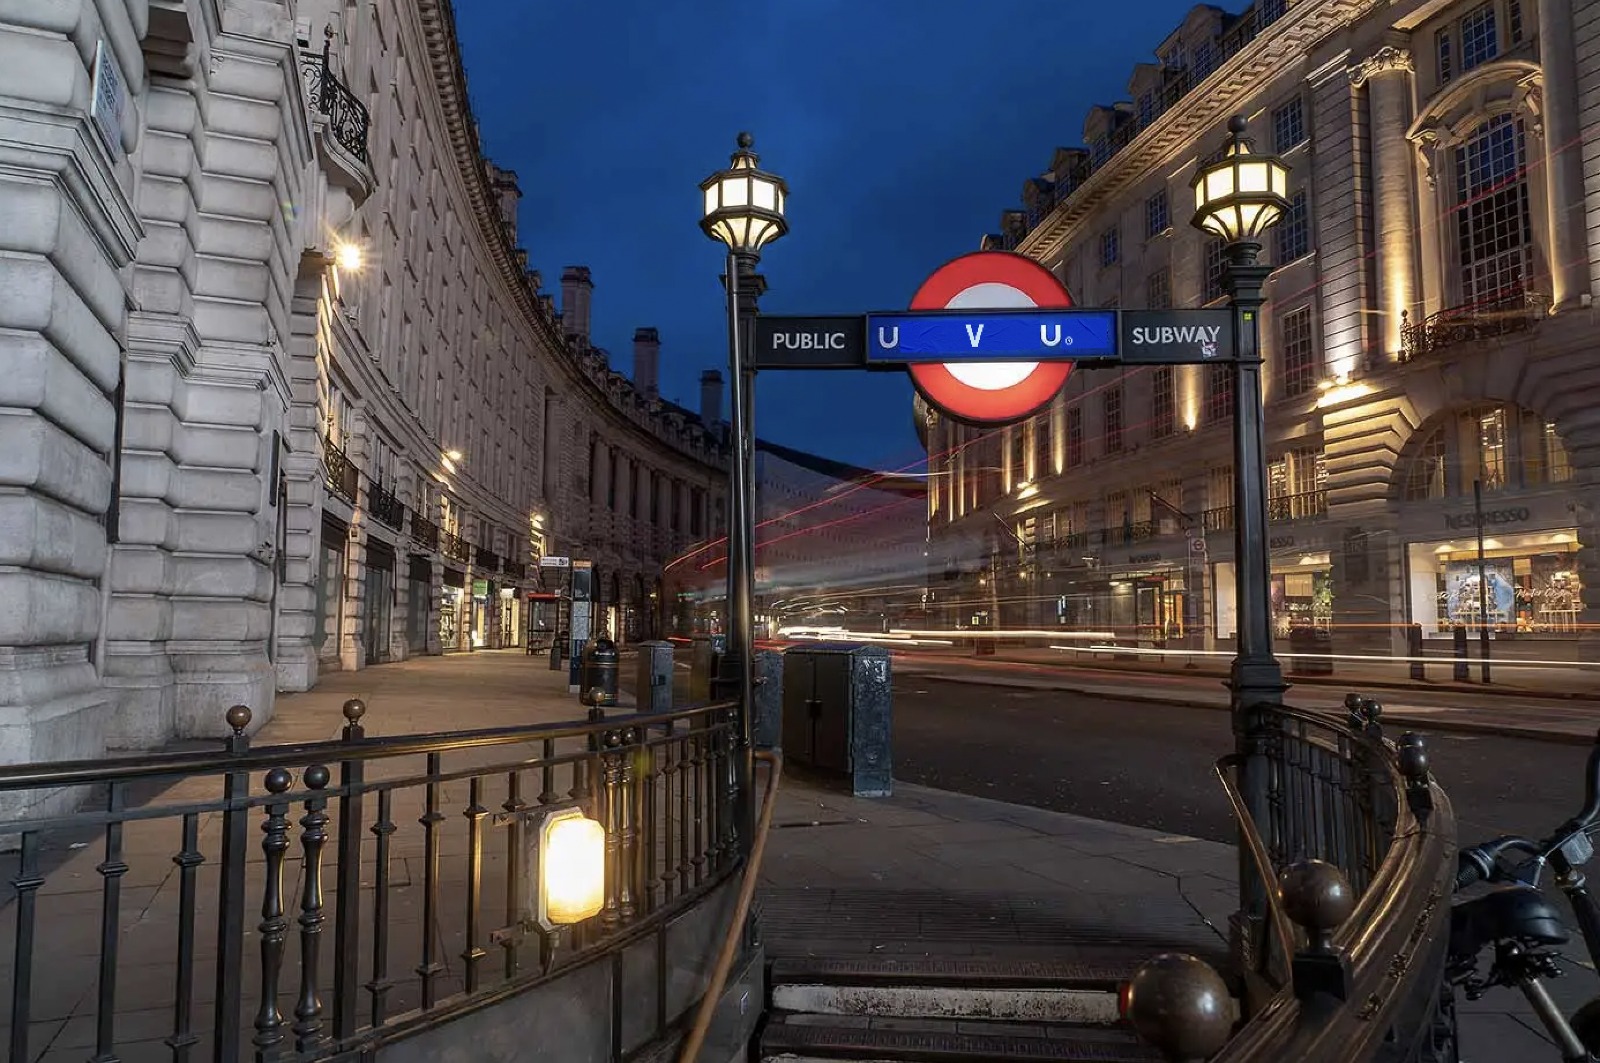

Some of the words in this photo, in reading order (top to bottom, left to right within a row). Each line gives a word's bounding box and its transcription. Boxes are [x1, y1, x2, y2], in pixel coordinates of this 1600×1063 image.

[772, 332, 845, 350] PUBLIC
[879, 326, 899, 349] U
[965, 323, 985, 348] V
[1132, 325, 1221, 345] SUBWAY
